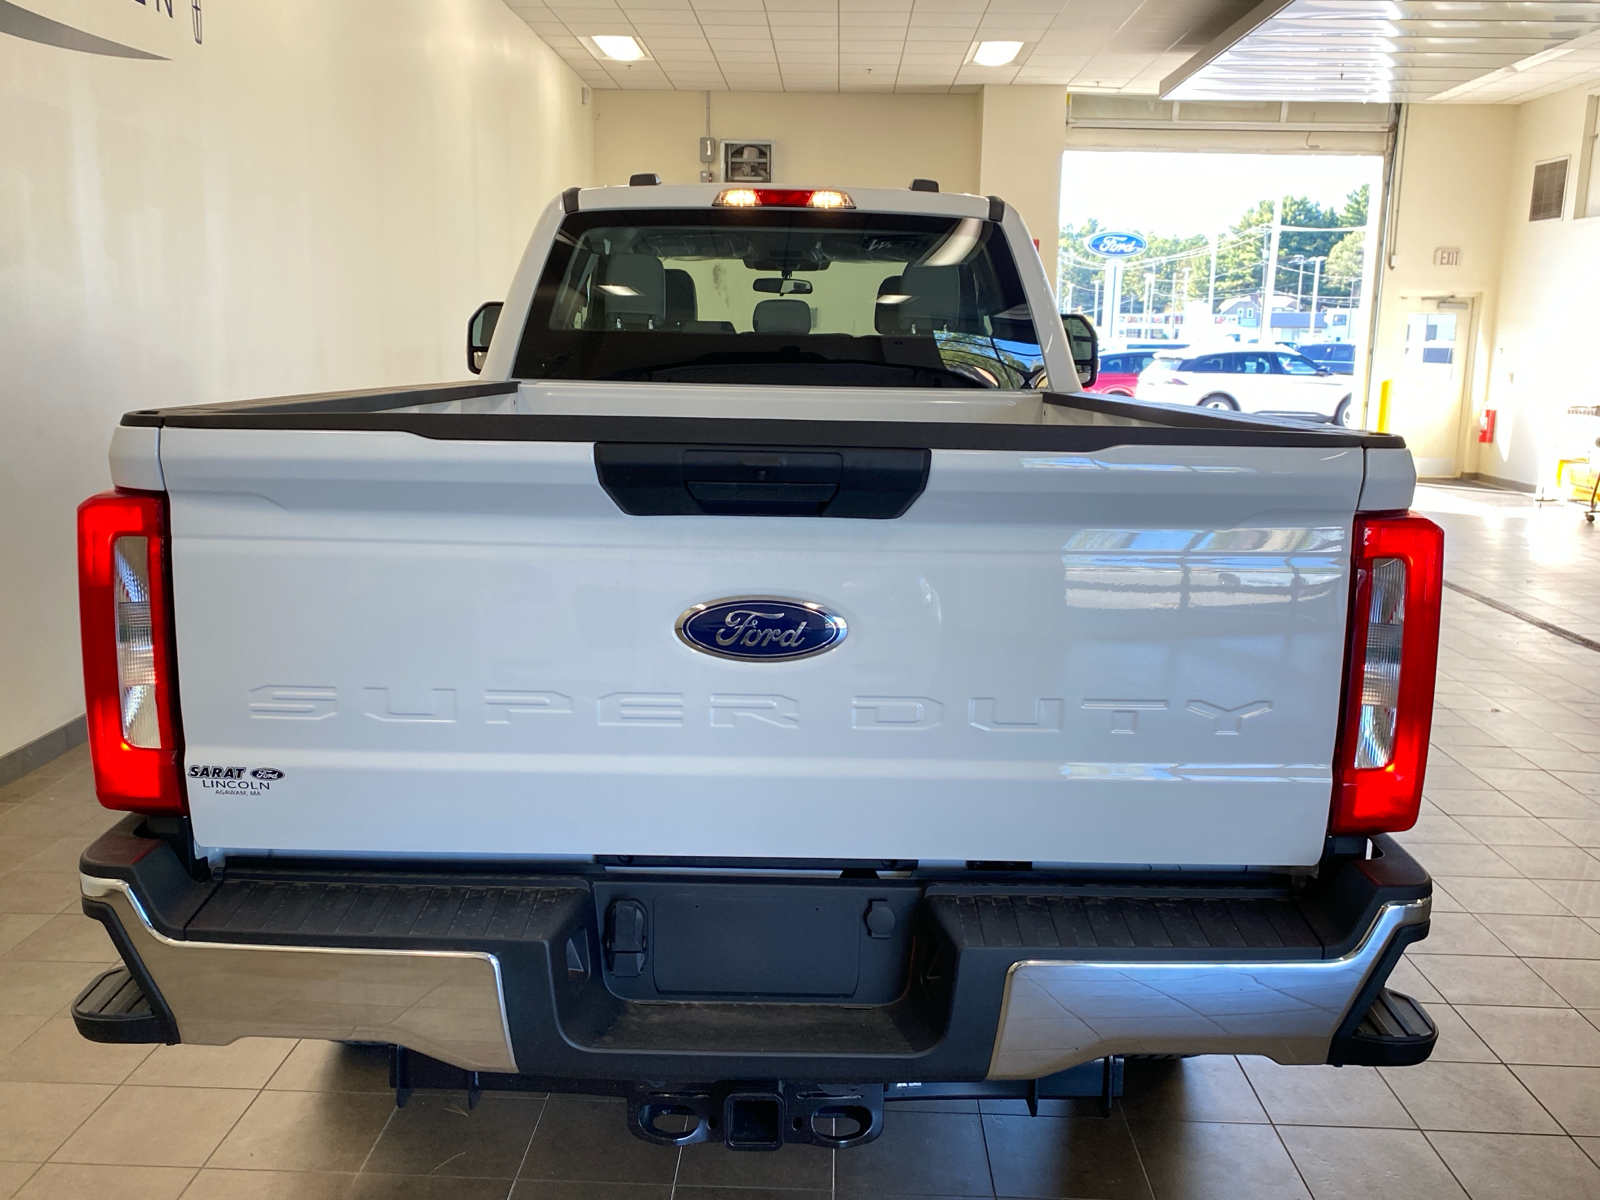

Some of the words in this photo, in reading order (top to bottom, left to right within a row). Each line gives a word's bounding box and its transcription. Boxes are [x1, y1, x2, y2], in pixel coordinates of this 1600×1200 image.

[1099, 236, 1137, 252] Ford
[1440, 250, 1460, 266] EXIT
[715, 610, 807, 648] Ford
[249, 684, 799, 729] SUPER
[851, 695, 1274, 736] DUTY
[188, 765, 246, 780] SARAT
[202, 780, 270, 790] LINCOLN
